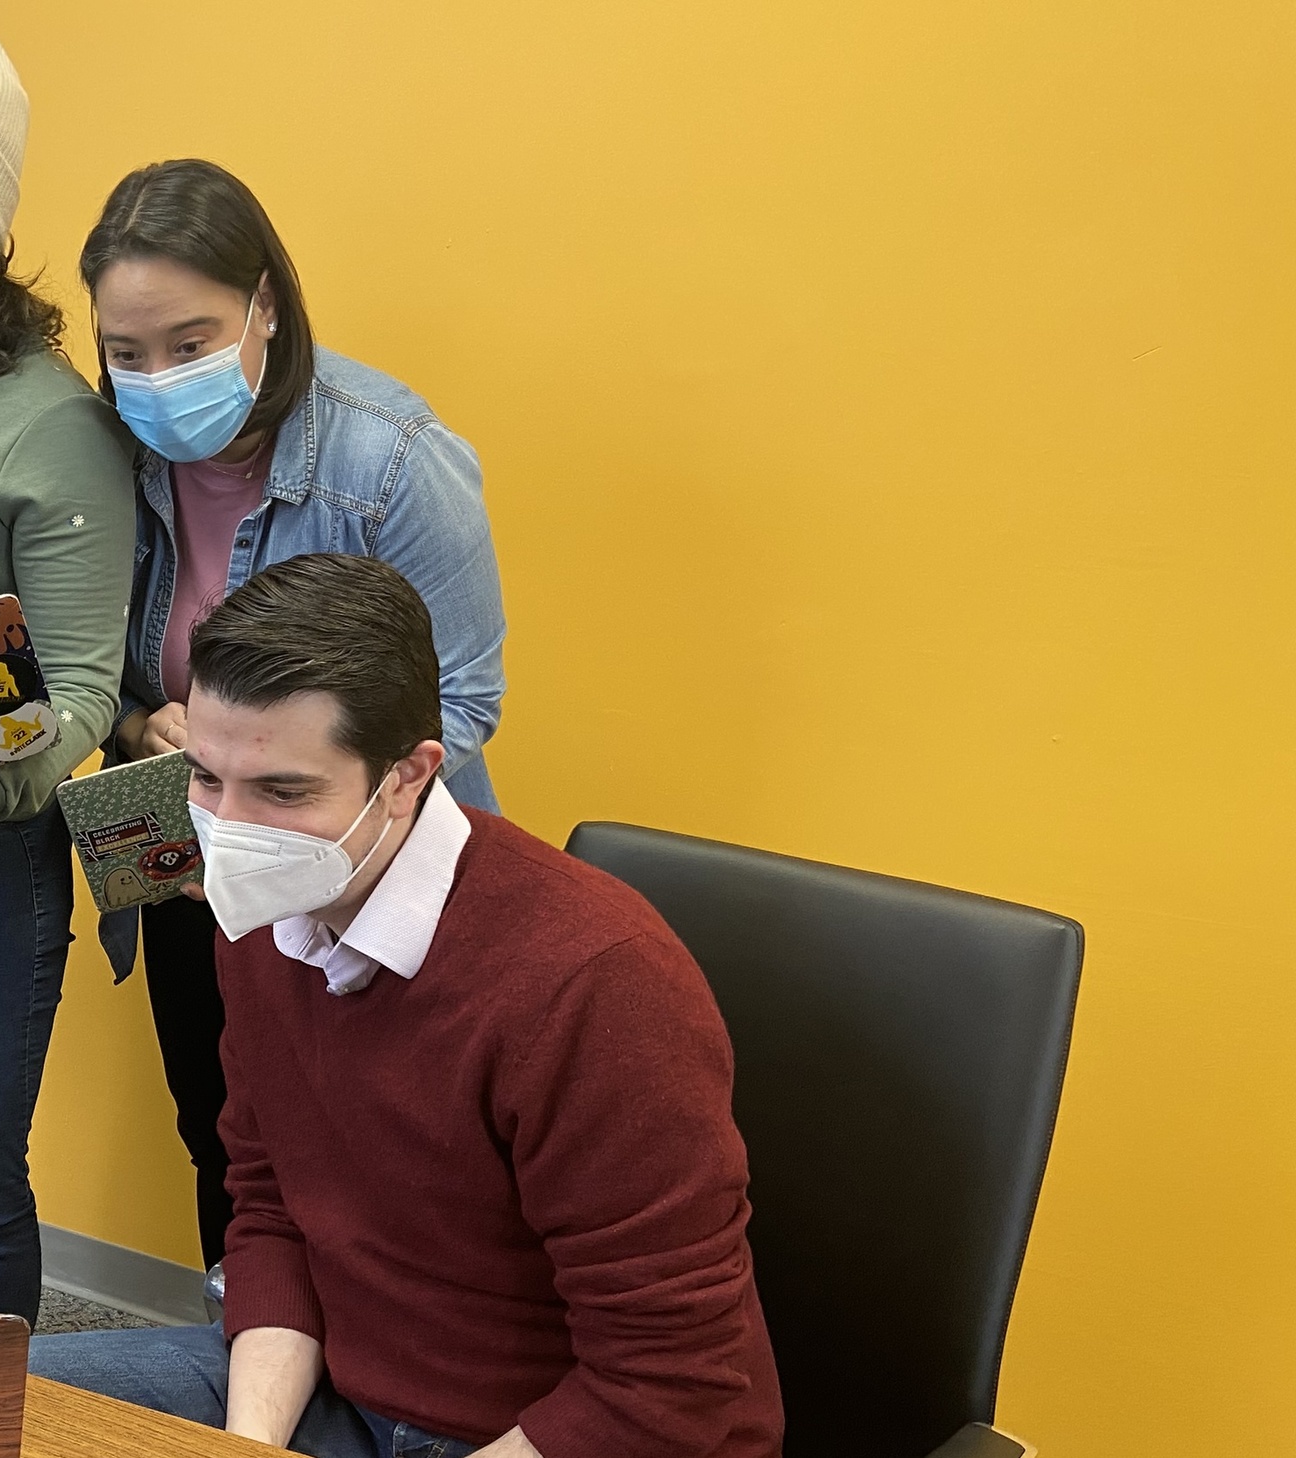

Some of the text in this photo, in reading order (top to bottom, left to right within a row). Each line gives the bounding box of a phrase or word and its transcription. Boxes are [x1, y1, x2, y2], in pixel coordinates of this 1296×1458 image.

[13, 730, 27, 740] 22
[92, 820, 142, 838] CELEBRATING
[95, 834, 120, 845] BLACK
[96, 833, 149, 852] EXCELLENCE
